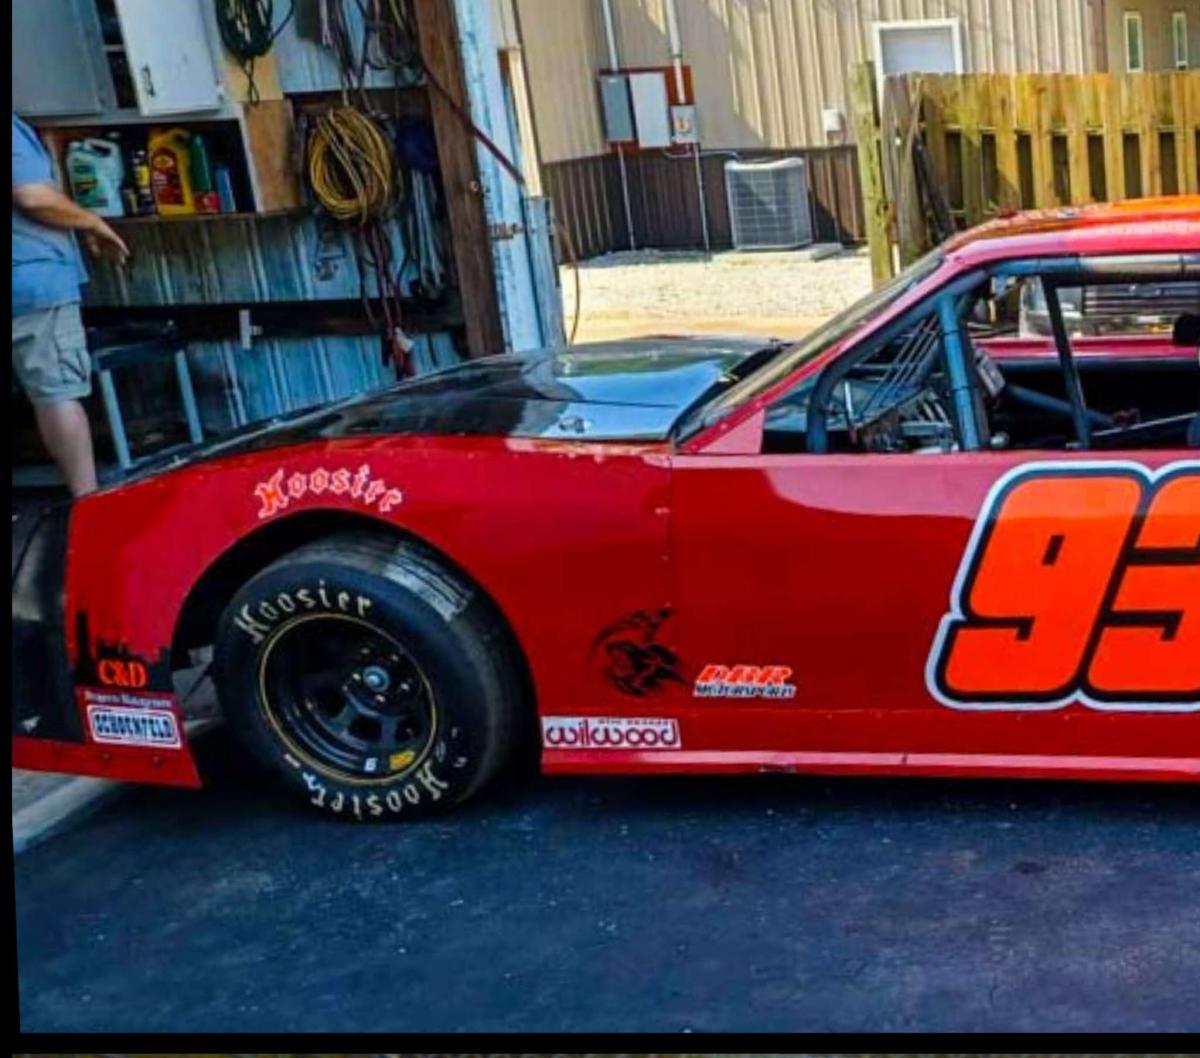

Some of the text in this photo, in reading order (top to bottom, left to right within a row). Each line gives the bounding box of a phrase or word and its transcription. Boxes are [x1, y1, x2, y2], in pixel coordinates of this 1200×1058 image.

[254, 464, 402, 519] Hoosier
[234, 579, 373, 644] Hoosier
[97, 660, 148, 688] C&D
[545, 718, 679, 746] wilwood
[310, 757, 449, 822] Hoosier
